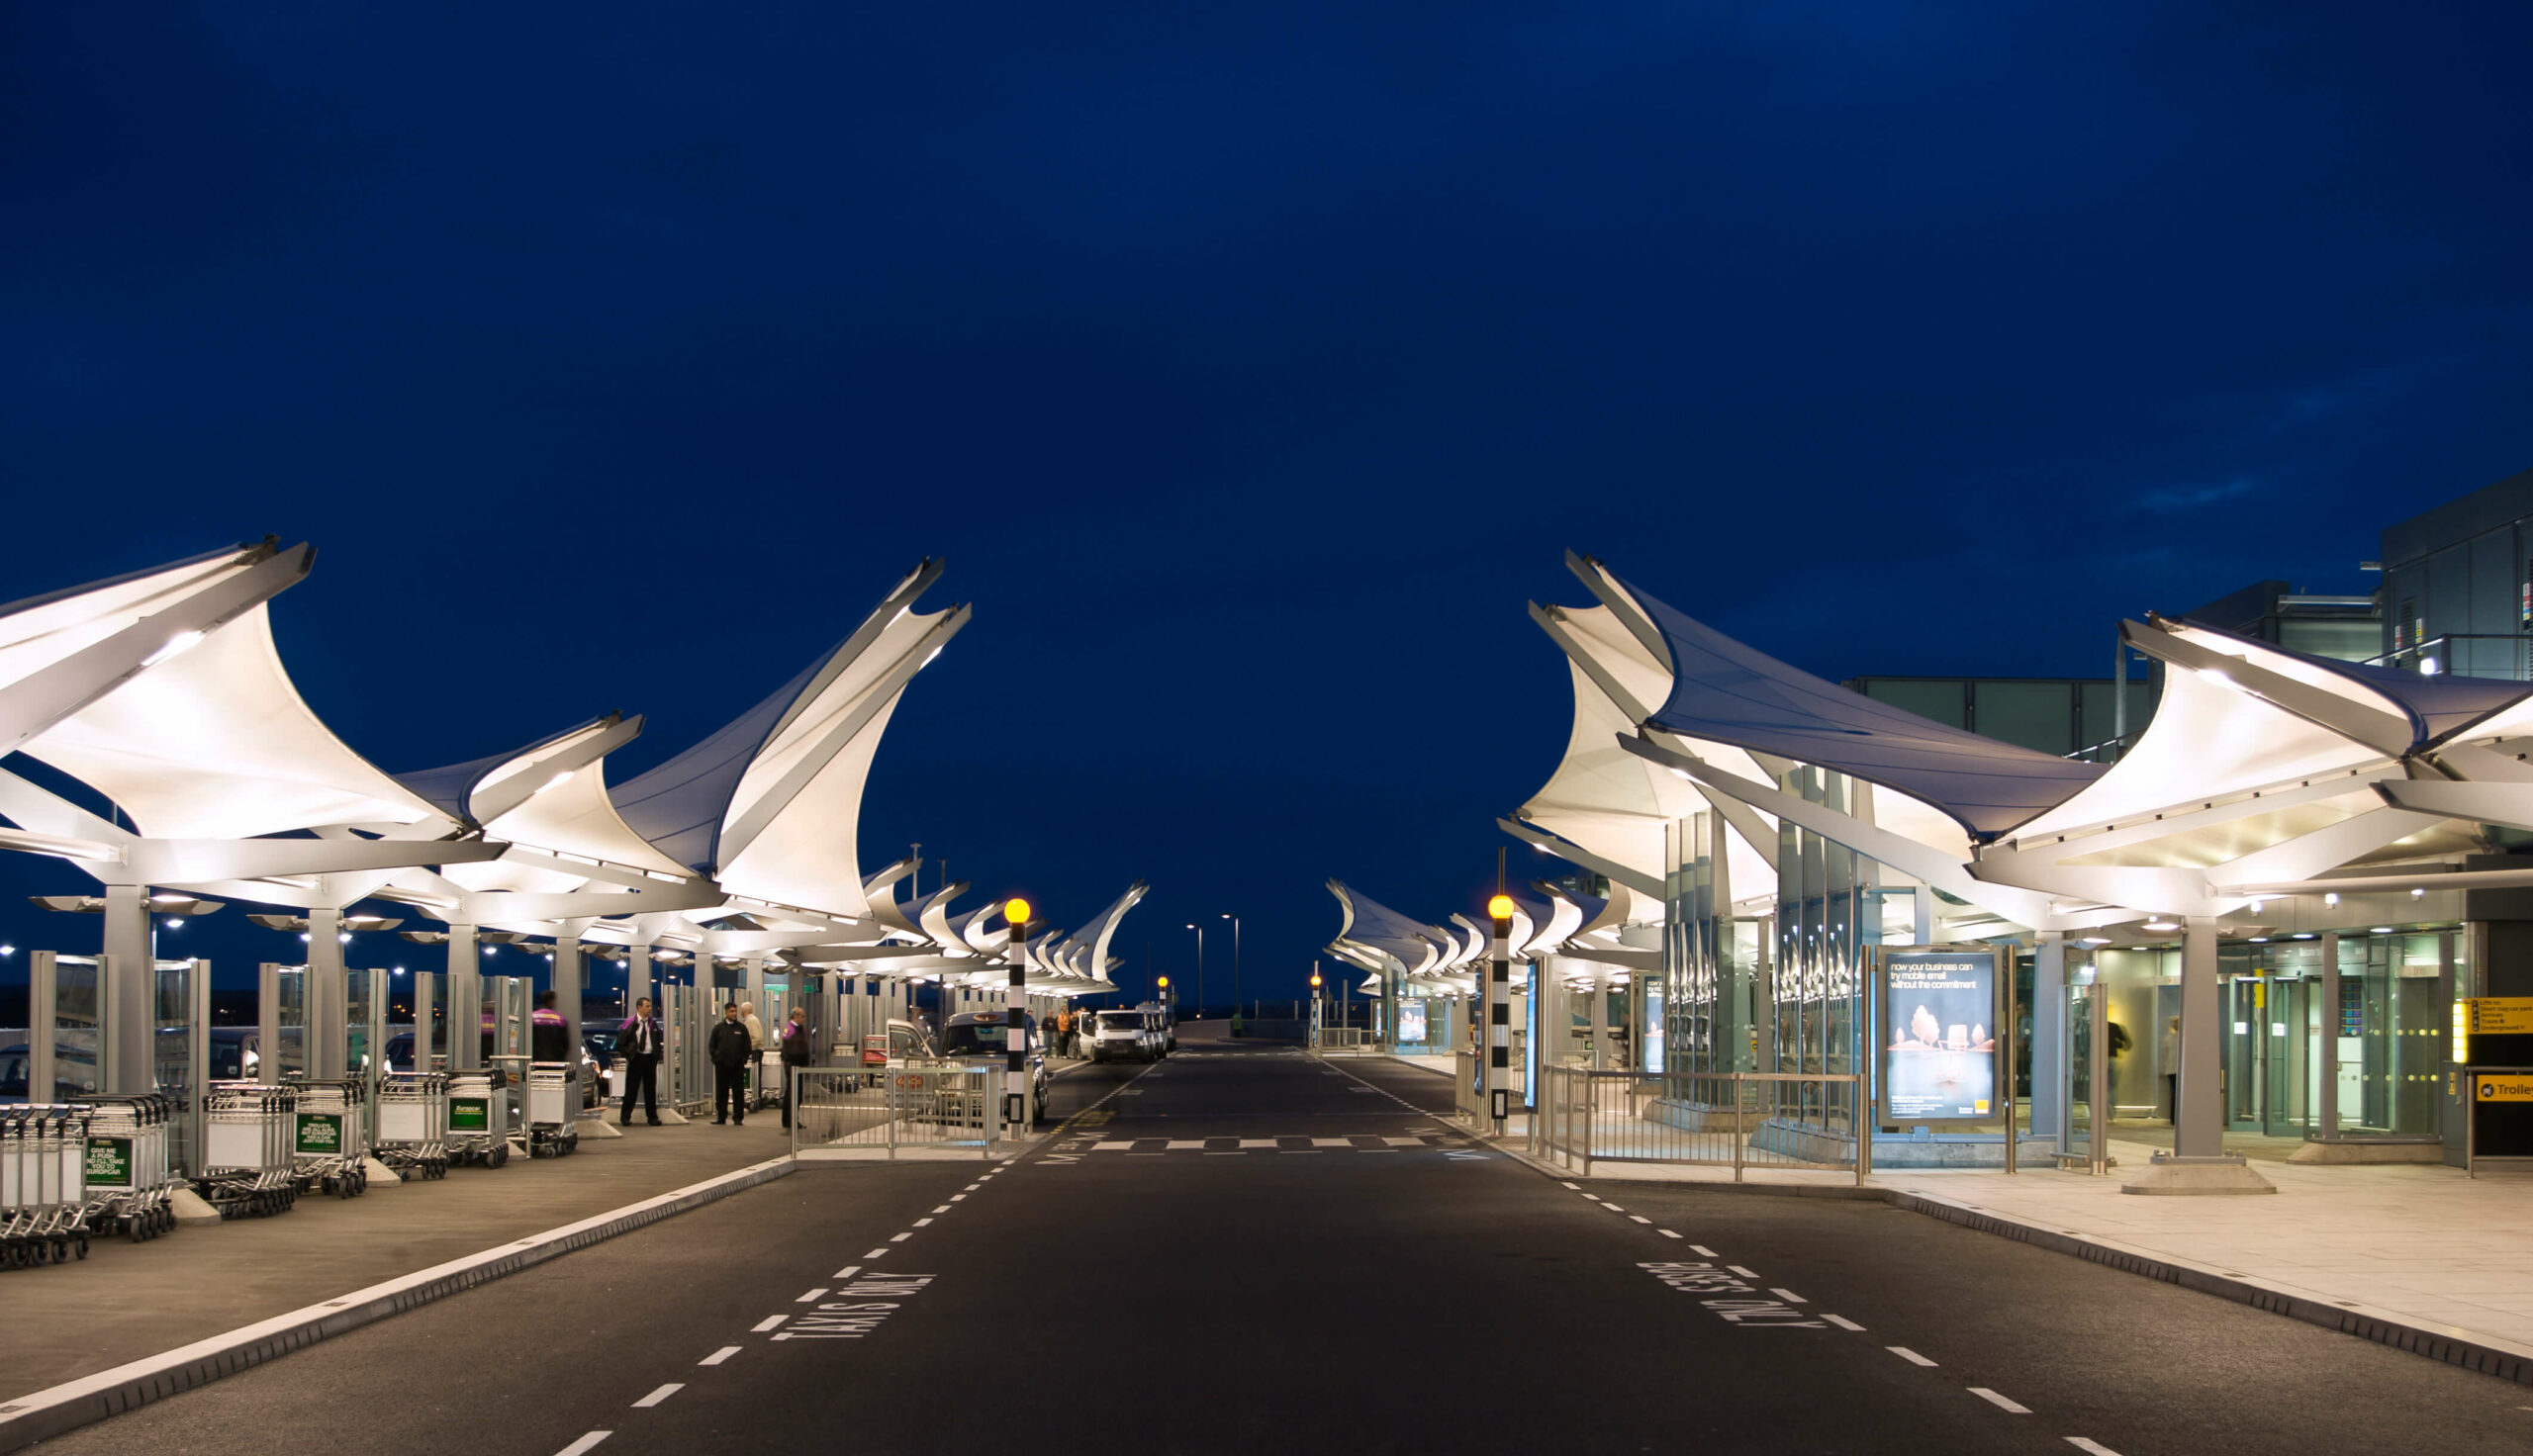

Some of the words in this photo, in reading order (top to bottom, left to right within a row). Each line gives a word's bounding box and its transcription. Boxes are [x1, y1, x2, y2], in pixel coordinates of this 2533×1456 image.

[1909, 963, 1923, 972] your
[1890, 971, 1901, 981] try
[1890, 980, 1918, 989] without
[1931, 980, 1977, 989] commitment
[1636, 1262, 1756, 1292] BUSES
[1699, 1300, 1829, 1328] ONLY
[770, 1303, 901, 1340] TAXIS
[837, 1272, 938, 1296] ONLY
